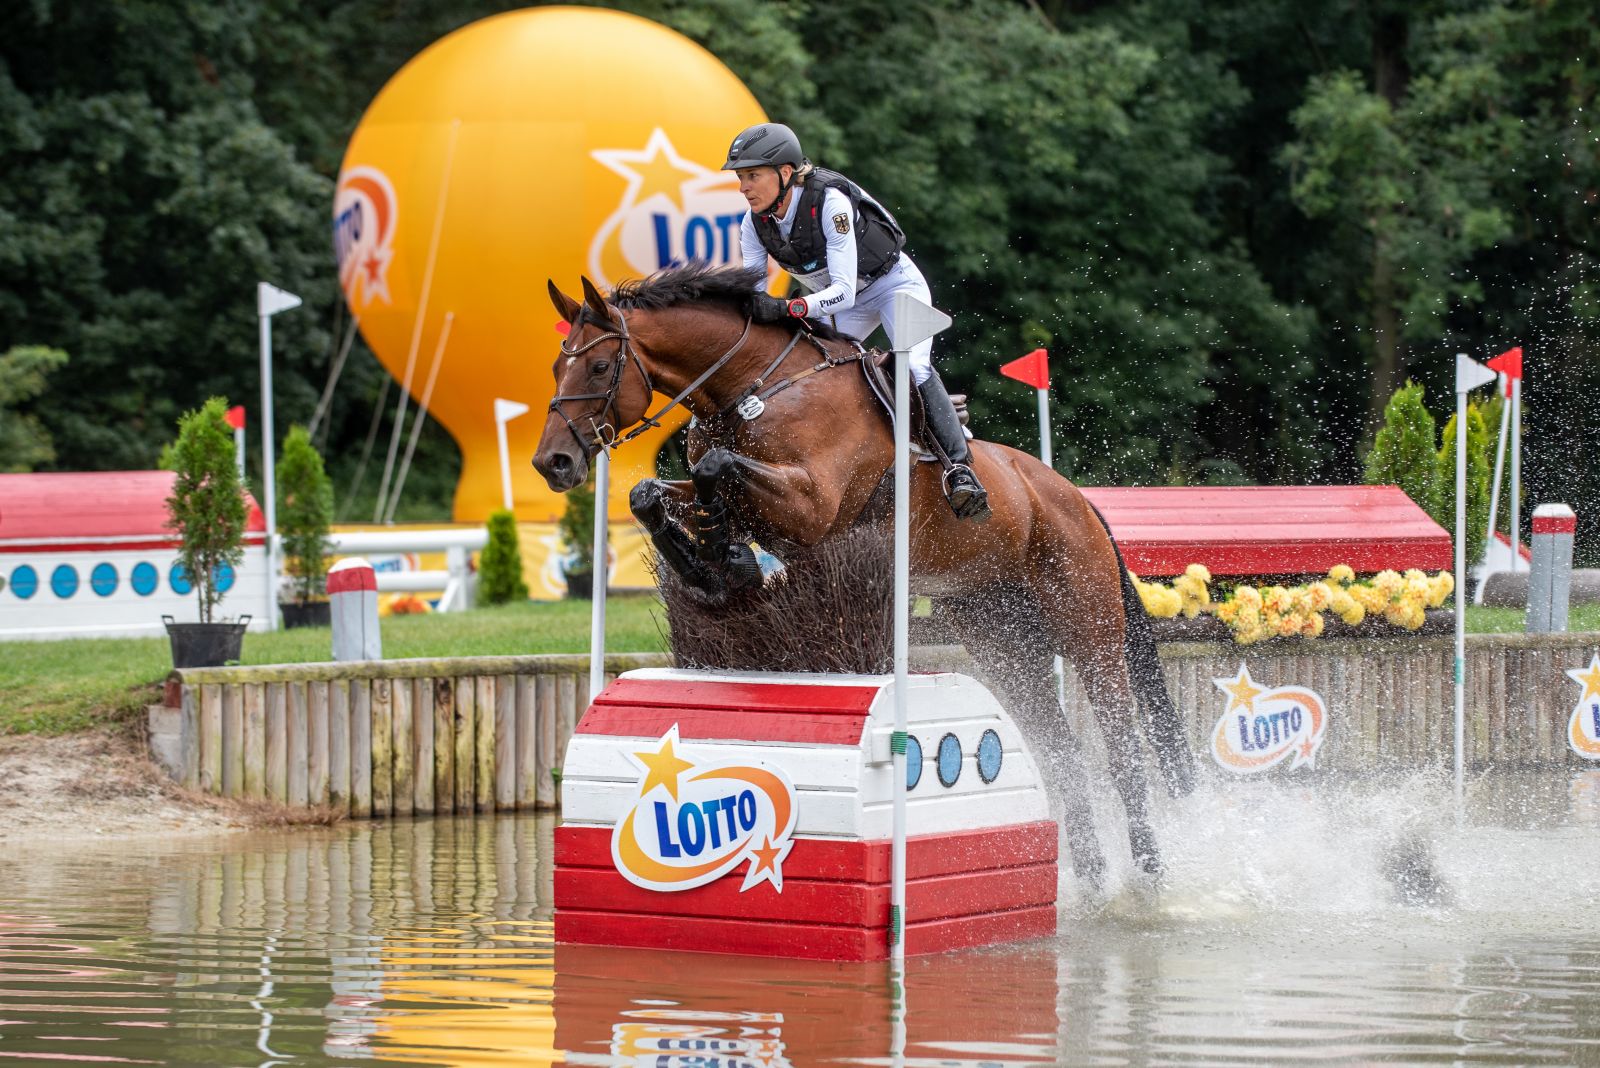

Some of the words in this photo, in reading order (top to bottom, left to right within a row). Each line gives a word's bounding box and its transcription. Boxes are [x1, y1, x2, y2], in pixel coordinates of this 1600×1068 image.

[653, 212, 747, 268] LOT
[741, 398, 762, 417] 420
[1238, 706, 1302, 752] LOTTO
[653, 789, 757, 858] LOTTO
